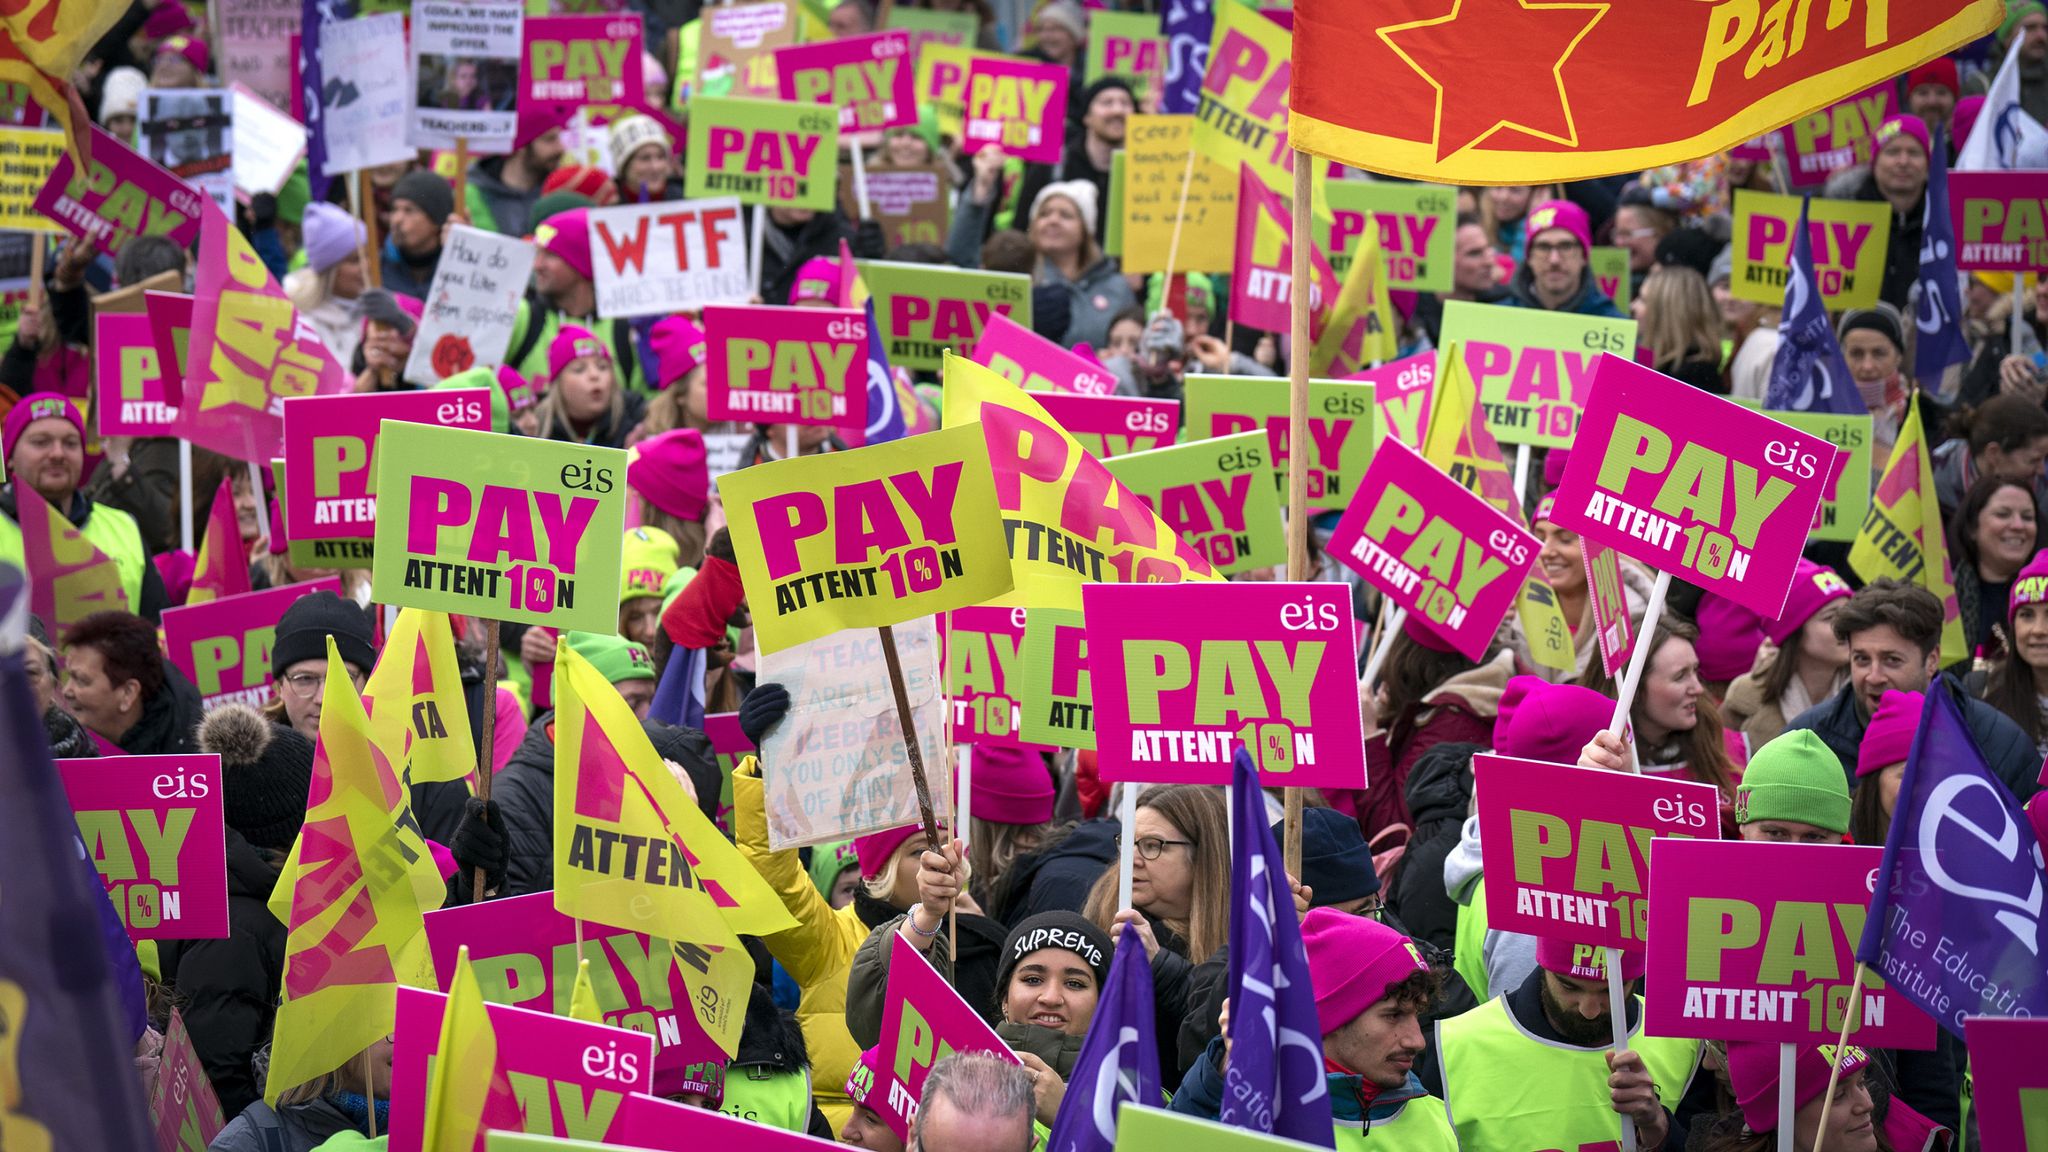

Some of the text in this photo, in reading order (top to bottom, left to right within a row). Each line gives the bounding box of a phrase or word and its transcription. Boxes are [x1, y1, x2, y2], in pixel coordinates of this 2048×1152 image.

[529, 40, 631, 82] PAY
[793, 58, 899, 104] PAY
[971, 74, 1057, 124] PAY
[799, 112, 832, 131] eis
[1792, 91, 1890, 155] PAY
[707, 126, 822, 178] PAY
[65, 159, 188, 238] PAY
[1962, 198, 2048, 243] PA
[595, 207, 737, 277] WTF
[1329, 209, 1439, 258] PAY
[1746, 213, 1874, 271] PAY
[487, 246, 508, 269] do
[985, 283, 1024, 302] eis
[827, 316, 868, 341] eis
[890, 294, 1013, 342] PAY
[1582, 326, 1626, 352] eis
[726, 337, 859, 395] PAY
[1073, 370, 1108, 395] eis
[1396, 362, 1433, 391] eis
[1465, 340, 1604, 411] PAY
[436, 397, 483, 425] eis
[1125, 407, 1170, 434] eis
[1324, 391, 1365, 416] eis
[560, 458, 614, 494] eis
[1217, 445, 1262, 473] eis
[1764, 438, 1819, 480] eis
[1595, 412, 1798, 551] PAY
[406, 474, 600, 575] PAY
[752, 460, 965, 581] PAY
[1362, 480, 1510, 609] PAY
[1488, 528, 1530, 567] eis
[627, 568, 668, 591] PAY
[1278, 594, 1340, 632] eis
[1122, 639, 1328, 728] PAY
[152, 766, 210, 800] eis
[780, 759, 824, 788] YOU
[831, 743, 885, 777] ONLY
[803, 787, 833, 817] OF
[1652, 793, 1707, 828] eis
[74, 807, 198, 887] AY
[1014, 927, 1102, 967] SUPREME
[1889, 902, 1927, 950] The
[471, 932, 676, 1017] PAY
[581, 1040, 639, 1084] eis
